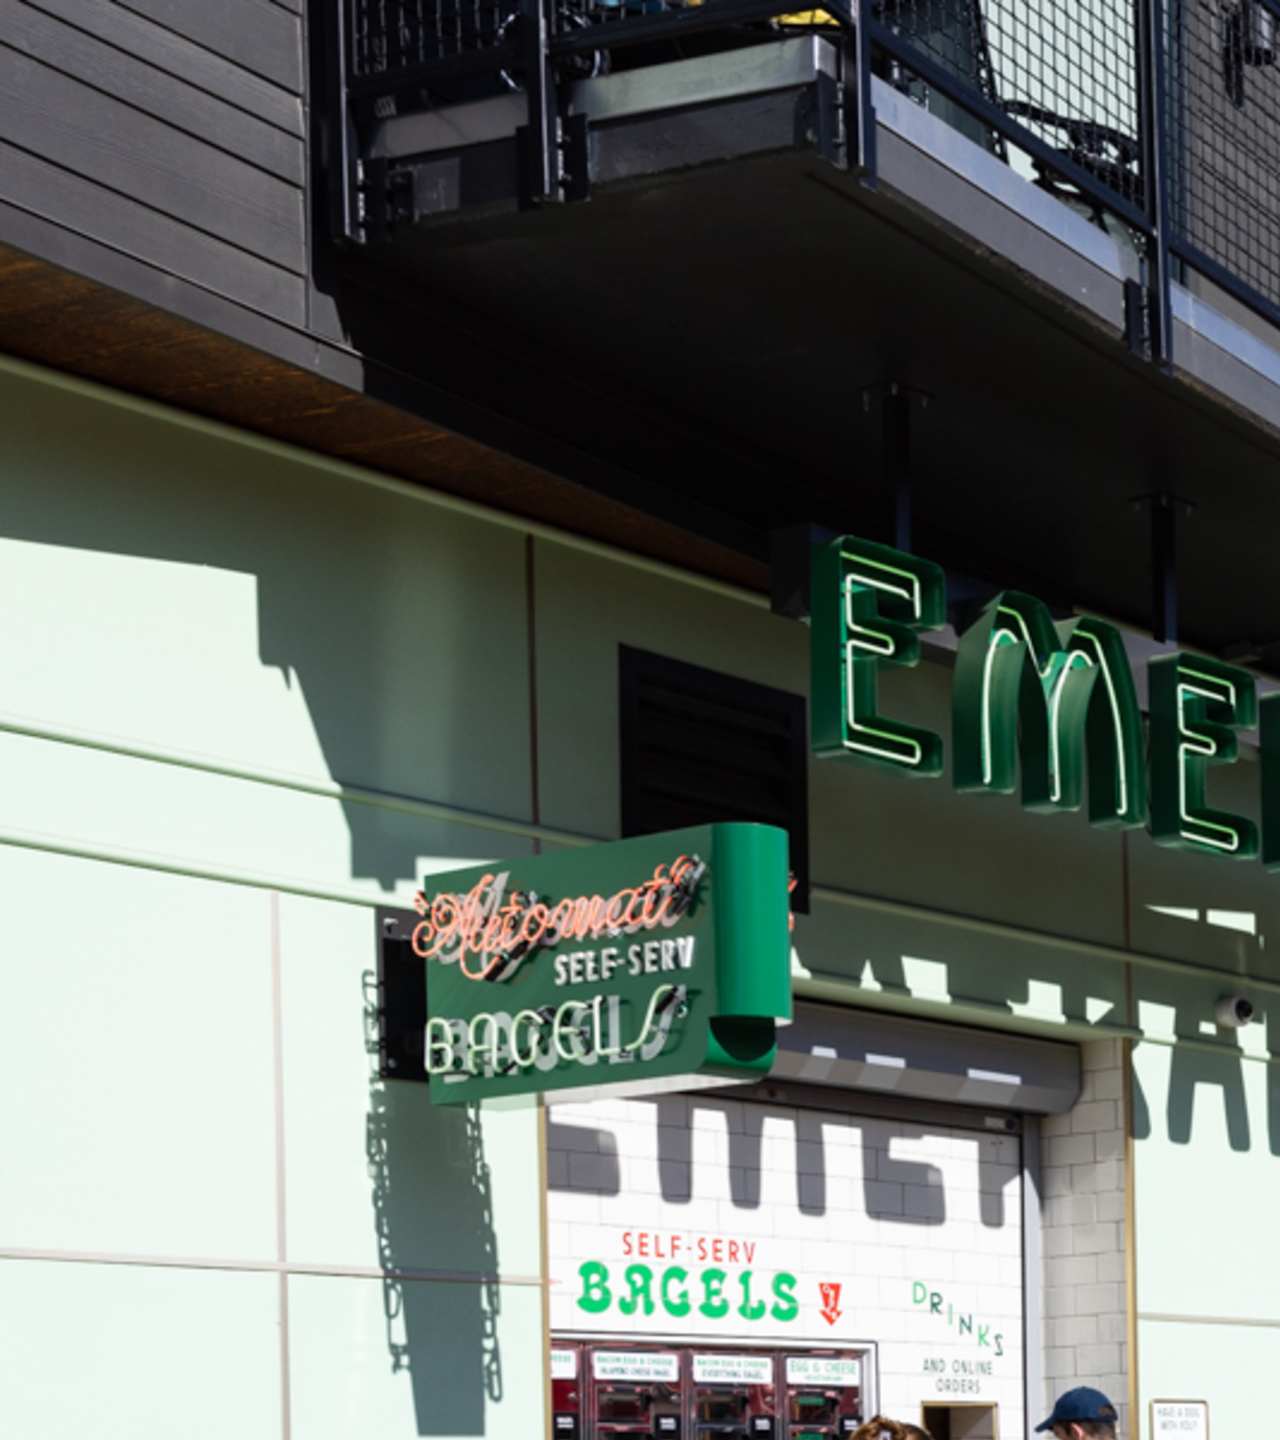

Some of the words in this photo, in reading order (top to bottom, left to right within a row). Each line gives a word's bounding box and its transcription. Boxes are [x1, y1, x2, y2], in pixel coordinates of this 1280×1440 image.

[554, 936, 695, 986] SELF-SERV
[425, 985, 688, 1080] BAGELS
[622, 1231, 755, 1265] SELF-SERV
[576, 1260, 799, 1322] BAGELS
[912, 1281, 1004, 1357] DRINKS
[923, 1358, 945, 1373] AND
[951, 1359, 992, 1375] ONLINE
[936, 1378, 980, 1394] ORDERS
